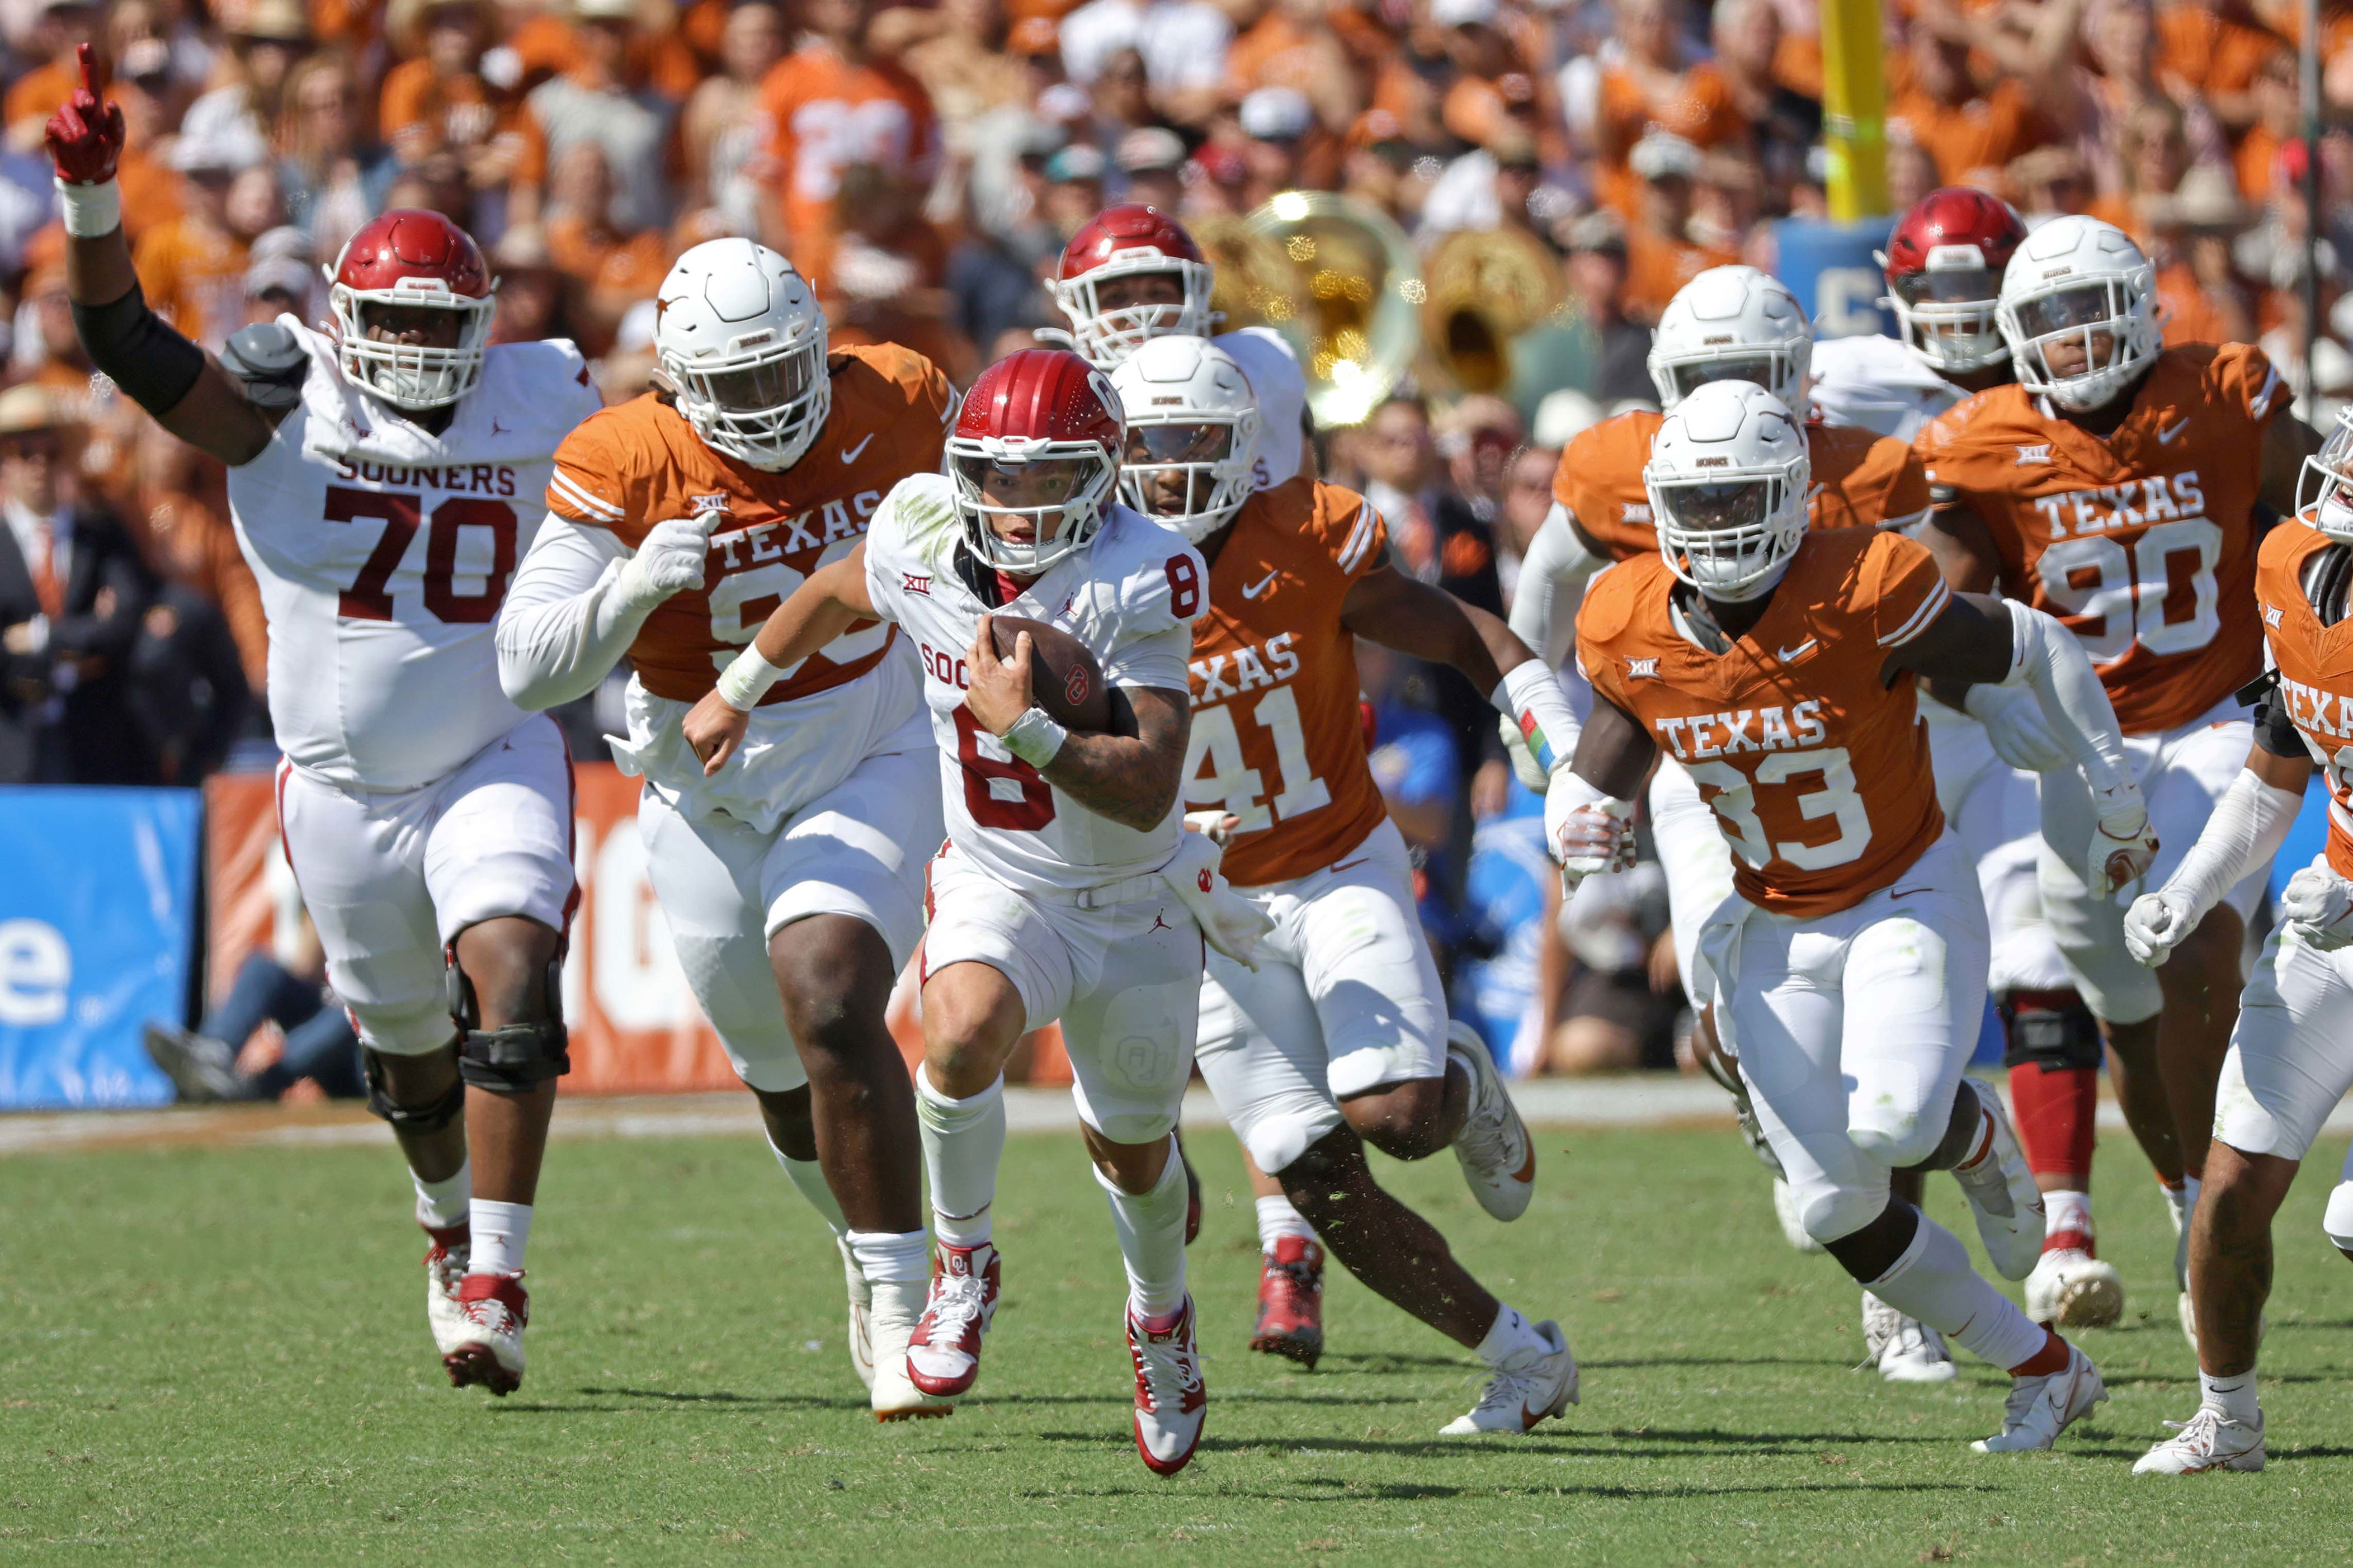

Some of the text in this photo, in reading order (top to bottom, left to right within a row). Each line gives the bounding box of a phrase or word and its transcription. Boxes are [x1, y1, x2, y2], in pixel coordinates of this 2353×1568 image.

[1695, 456, 1728, 467] HORNS
[710, 489, 881, 569] TEXAS
[2034, 470, 2205, 539] TEXAS
[323, 485, 518, 624] 70
[903, 572, 932, 594] XII
[1164, 552, 1200, 619] 8
[2035, 516, 2224, 665] 90
[1189, 632, 1300, 707] XAS
[1624, 655, 1662, 680] XII
[1180, 684, 1332, 834] 41
[1656, 700, 1826, 759] TEXAS
